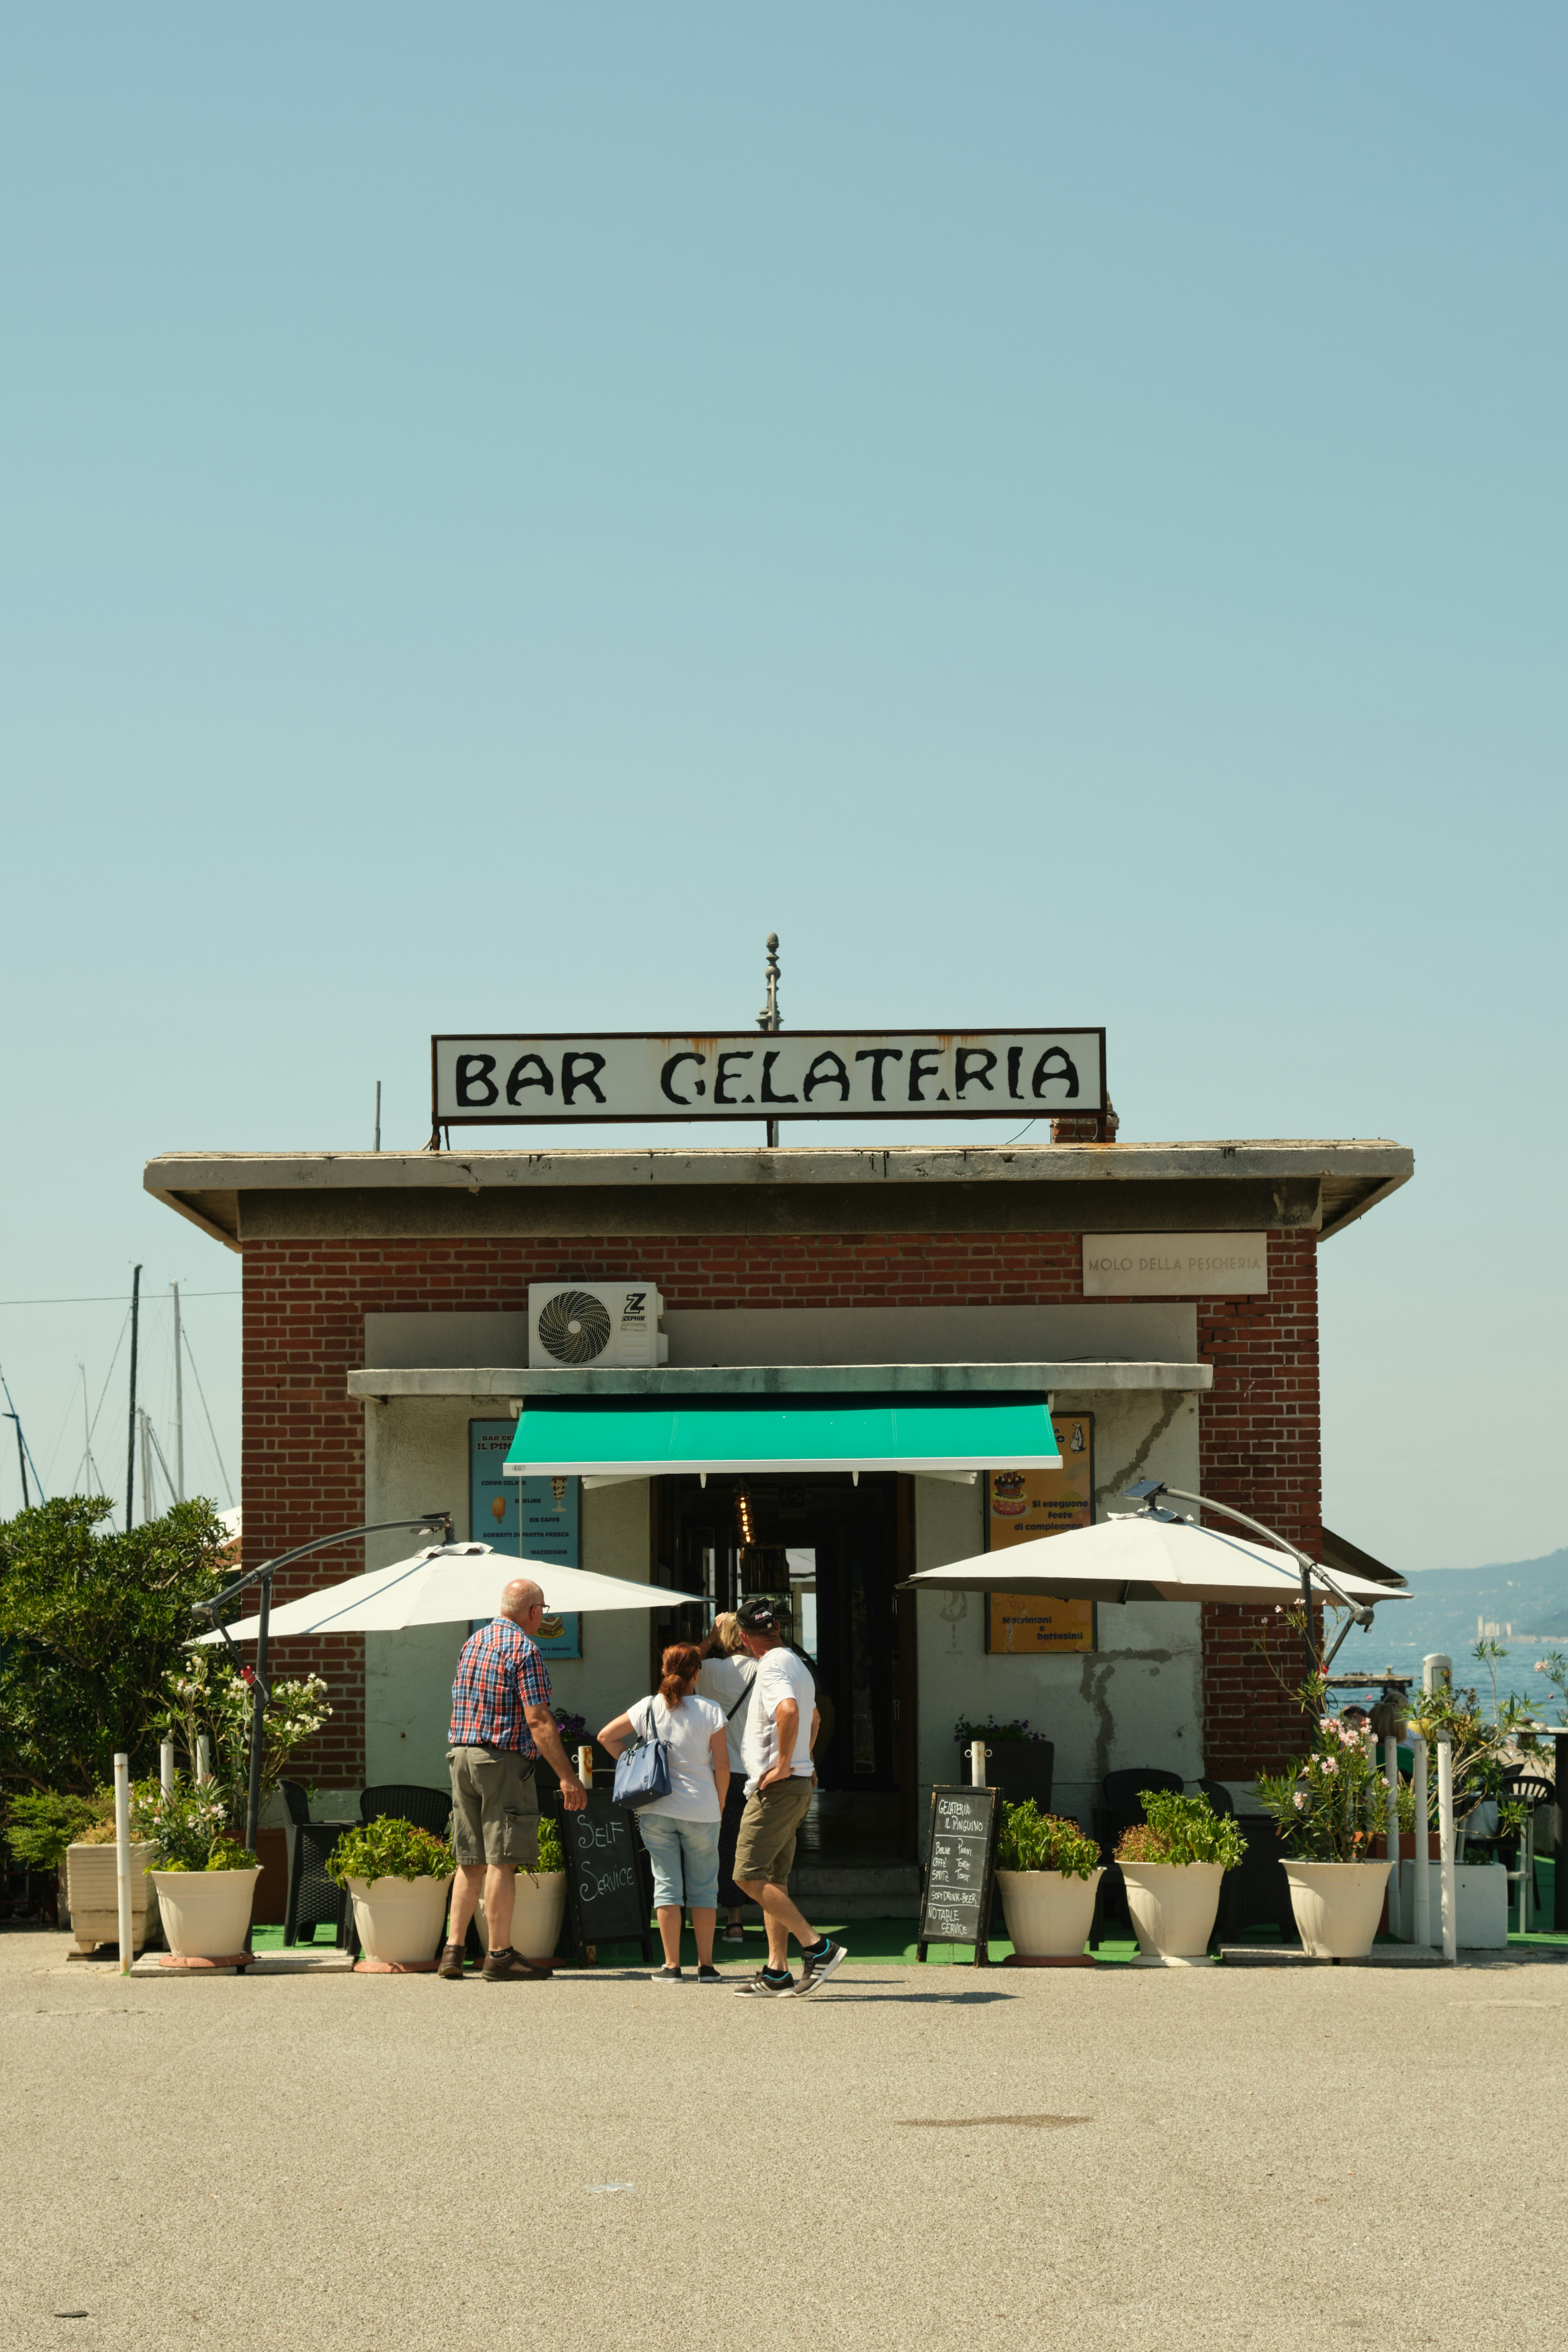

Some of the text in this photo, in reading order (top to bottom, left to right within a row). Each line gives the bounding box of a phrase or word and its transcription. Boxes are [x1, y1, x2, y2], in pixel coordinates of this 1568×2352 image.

[455, 1046, 1080, 1107] BAR GELATERIA
[1088, 1257, 1261, 1271] MOLO DELLA PESCHERIA
[1025, 1523, 1083, 1531] compleanno
[938, 1799, 971, 1816] GELATERIA
[577, 1814, 625, 1848] SELF
[945, 1815, 983, 1832] IL PINGUINO
[580, 1861, 634, 1901] SERVICE
[932, 1868, 971, 1882] SPRITZ TOAST
[941, 1922, 968, 1935] SERVICE
